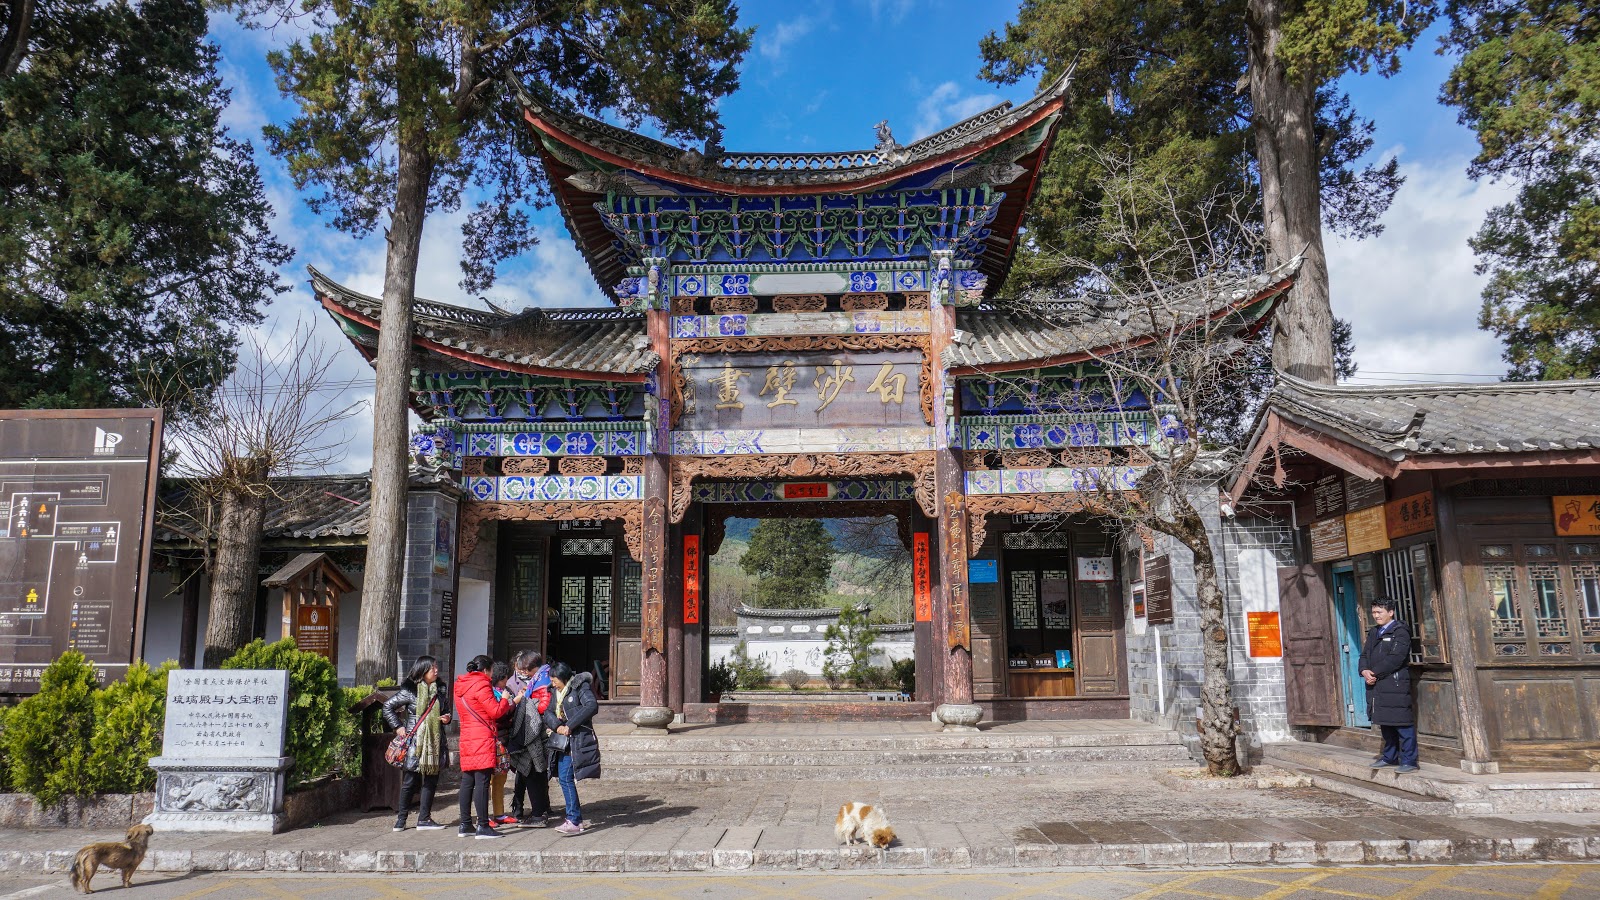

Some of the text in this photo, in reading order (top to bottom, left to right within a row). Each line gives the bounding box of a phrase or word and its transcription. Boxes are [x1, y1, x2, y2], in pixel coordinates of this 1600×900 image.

[172, 694, 278, 705] 琉璃殿与大宝积宫
